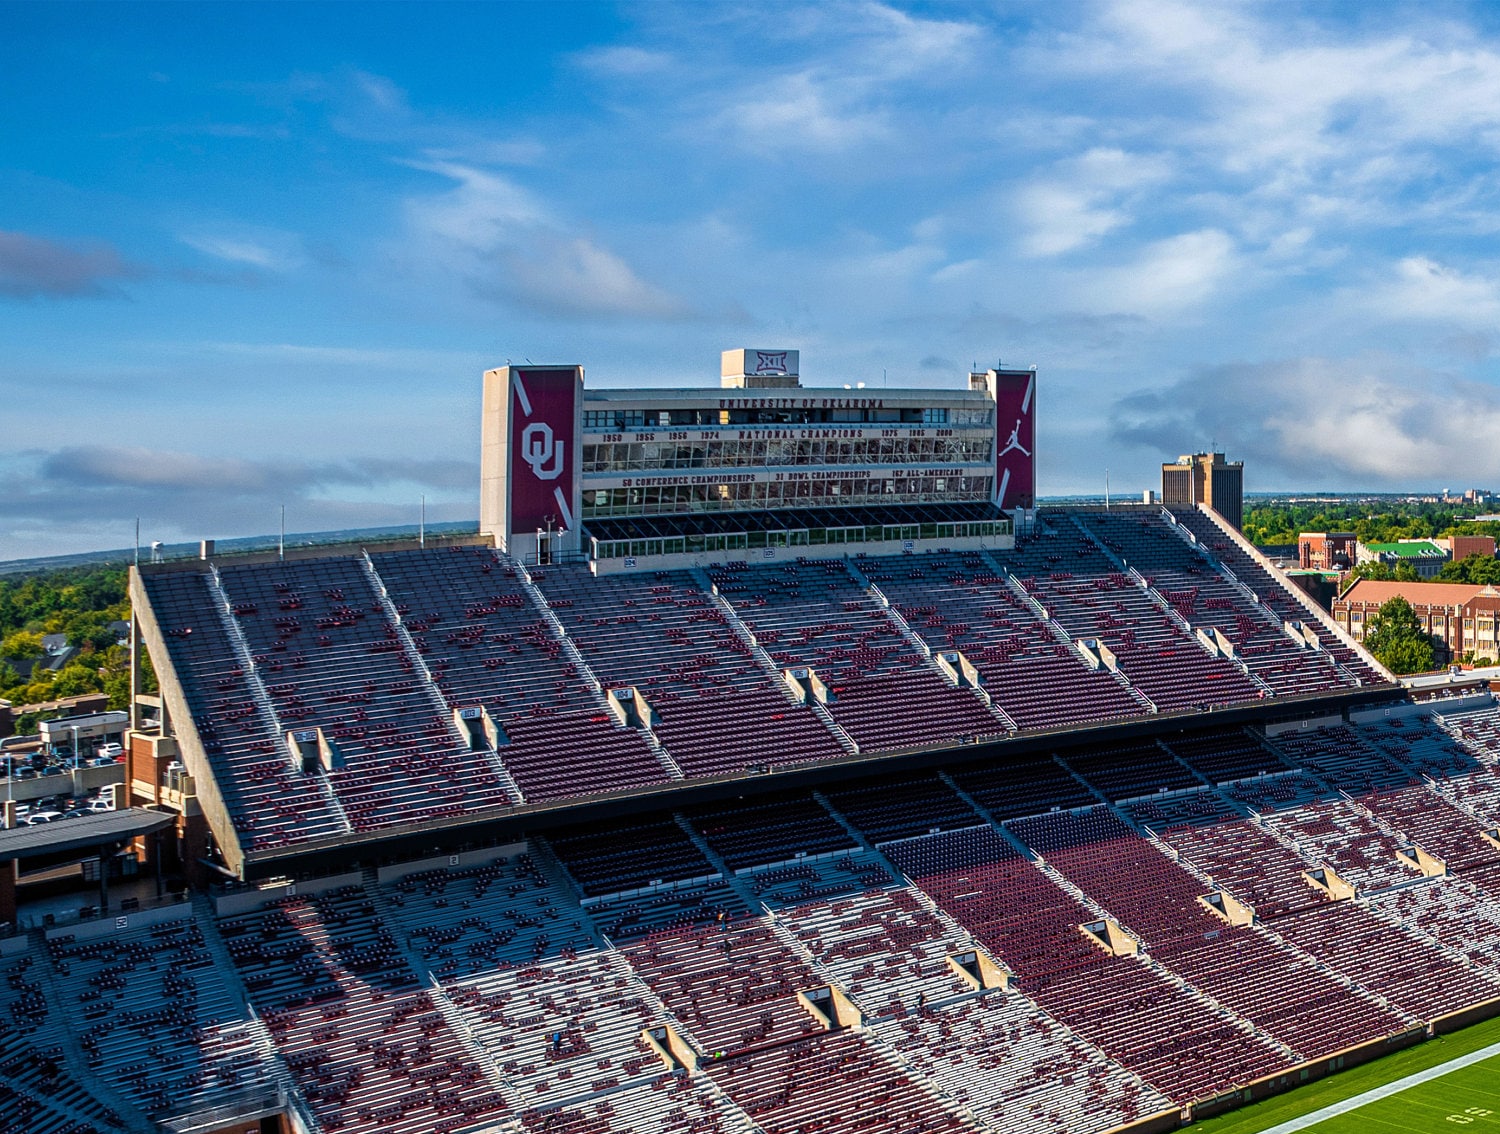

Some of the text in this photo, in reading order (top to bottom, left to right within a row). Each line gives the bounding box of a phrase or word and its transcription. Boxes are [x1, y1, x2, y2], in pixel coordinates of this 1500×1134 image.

[720, 399, 884, 409] UNIVERSITY OF OKLAHOMA
[603, 434, 622, 443] 1950
[636, 433, 655, 441] 1955
[669, 432, 688, 440] 1956
[701, 431, 719, 440] 1974
[739, 430, 795, 439] NATIONAL
[801, 429, 863, 439] CHAMPIONS
[882, 429, 898, 437] 1975
[521, 422, 565, 480] OU
[635, 476, 688, 486] CONFERENCE
[691, 474, 755, 484] CHAMPIONSHIPS
[788, 472, 809, 480] BOWL
[811, 470, 871, 480] CHAMPIONSHIPS
[906, 468, 963, 477] ALL-AMERICANS
